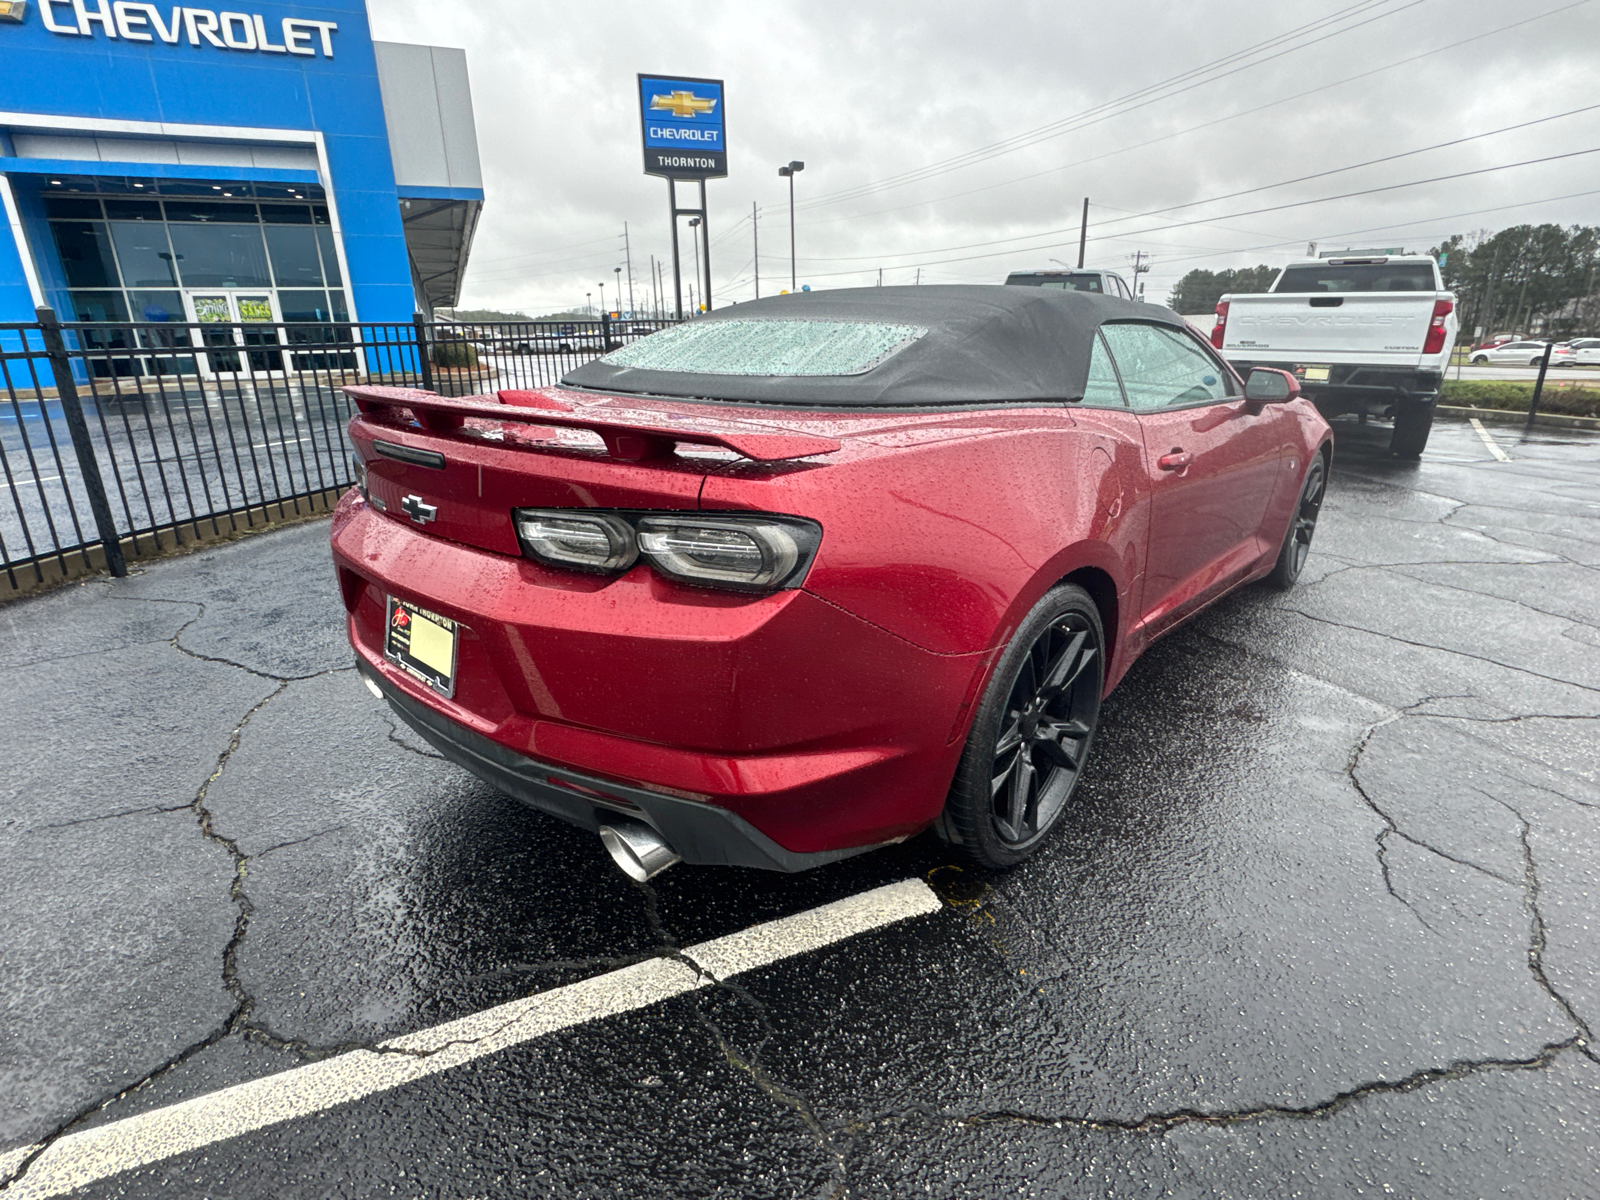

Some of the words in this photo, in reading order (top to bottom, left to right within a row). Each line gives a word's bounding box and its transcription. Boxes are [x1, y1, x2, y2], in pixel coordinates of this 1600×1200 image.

[37, 0, 338, 58] CHEVROLET
[649, 127, 719, 142] CHEVROLET
[657, 156, 715, 168] THORNTON
[1238, 315, 1416, 326] CHEVROLET
